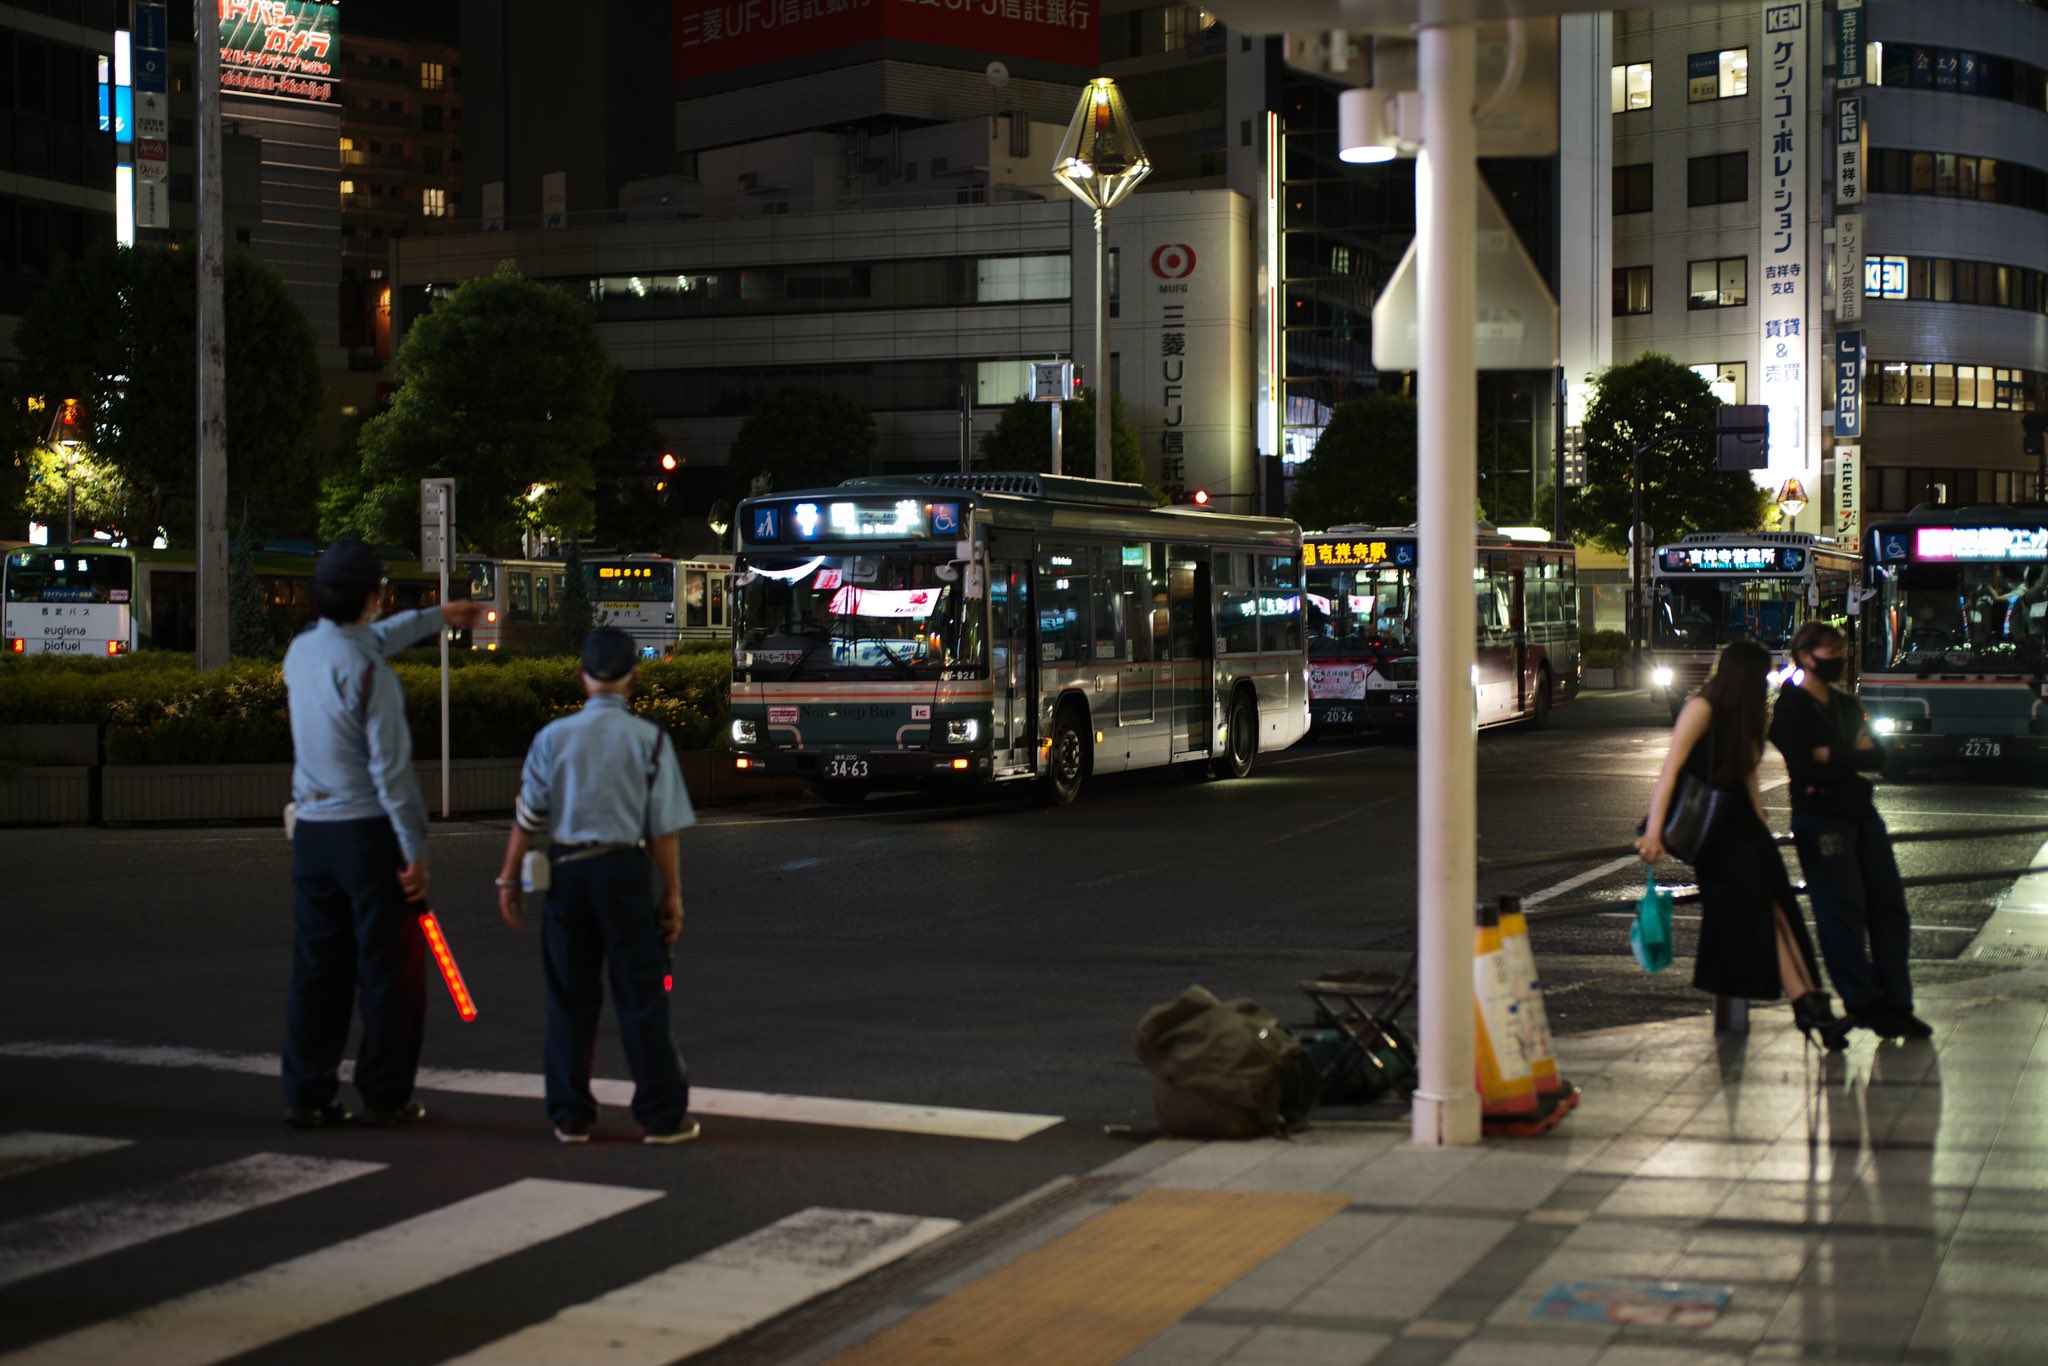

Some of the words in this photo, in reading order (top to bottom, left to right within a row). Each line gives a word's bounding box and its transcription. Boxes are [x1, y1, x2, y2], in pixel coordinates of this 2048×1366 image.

[904, 0, 1091, 29] J信託銀行
[1767, 6, 1799, 31] KEN
[264, 26, 331, 58] カメラ
[1841, 102, 1858, 143] KEN
[1773, 41, 1794, 254] ケン・コーポレーション
[1842, 150, 1856, 198] 吉祥寺
[1765, 263, 1801, 280] 吉祥寺
[1865, 264, 1903, 291] KEN
[1159, 284, 1187, 294] MUFG
[1771, 281, 1795, 296] 支店
[1765, 318, 1800, 339] 賃貸
[1776, 342, 1788, 358] &
[1840, 340, 1855, 353] J
[1840, 361, 1855, 429] PREP
[1883, 376, 1925, 396] stye
[1317, 542, 1387, 561] 吉祥寺駅
[42, 607, 89, 617] 西武バス
[44, 625, 86, 639] euglena
[44, 640, 81, 651] biofuel
[870, 705, 896, 717] Bus
